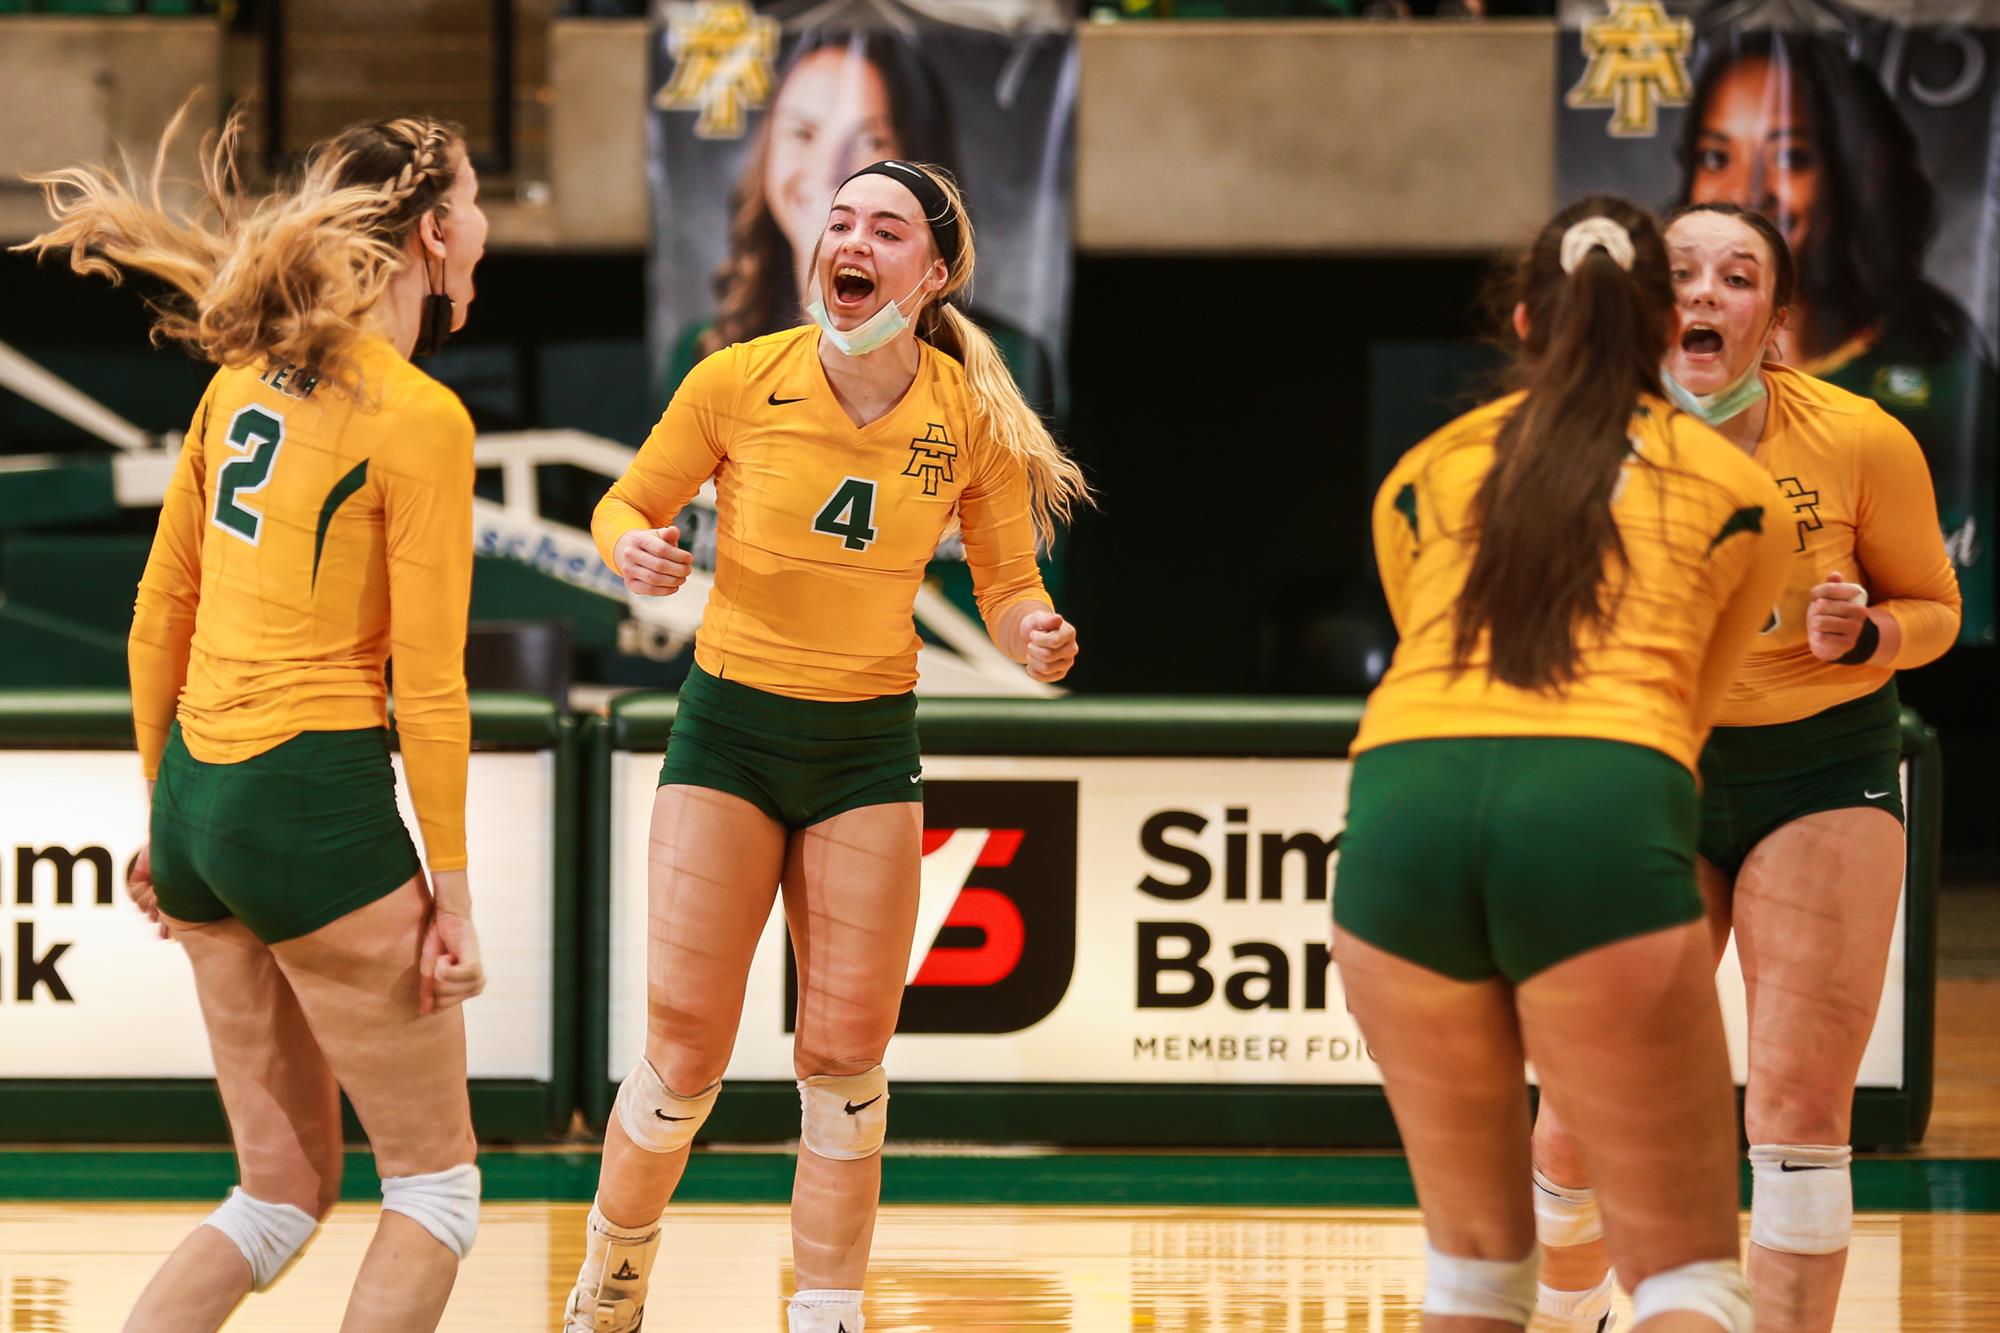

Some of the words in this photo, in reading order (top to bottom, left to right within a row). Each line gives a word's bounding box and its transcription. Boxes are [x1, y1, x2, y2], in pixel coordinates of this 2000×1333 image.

[260, 363, 318, 398] EH
[212, 403, 285, 547] 2
[811, 475, 879, 553] 4
[1133, 1037, 1290, 1062] MEMBER
[1306, 1037, 1377, 1063] FDI
